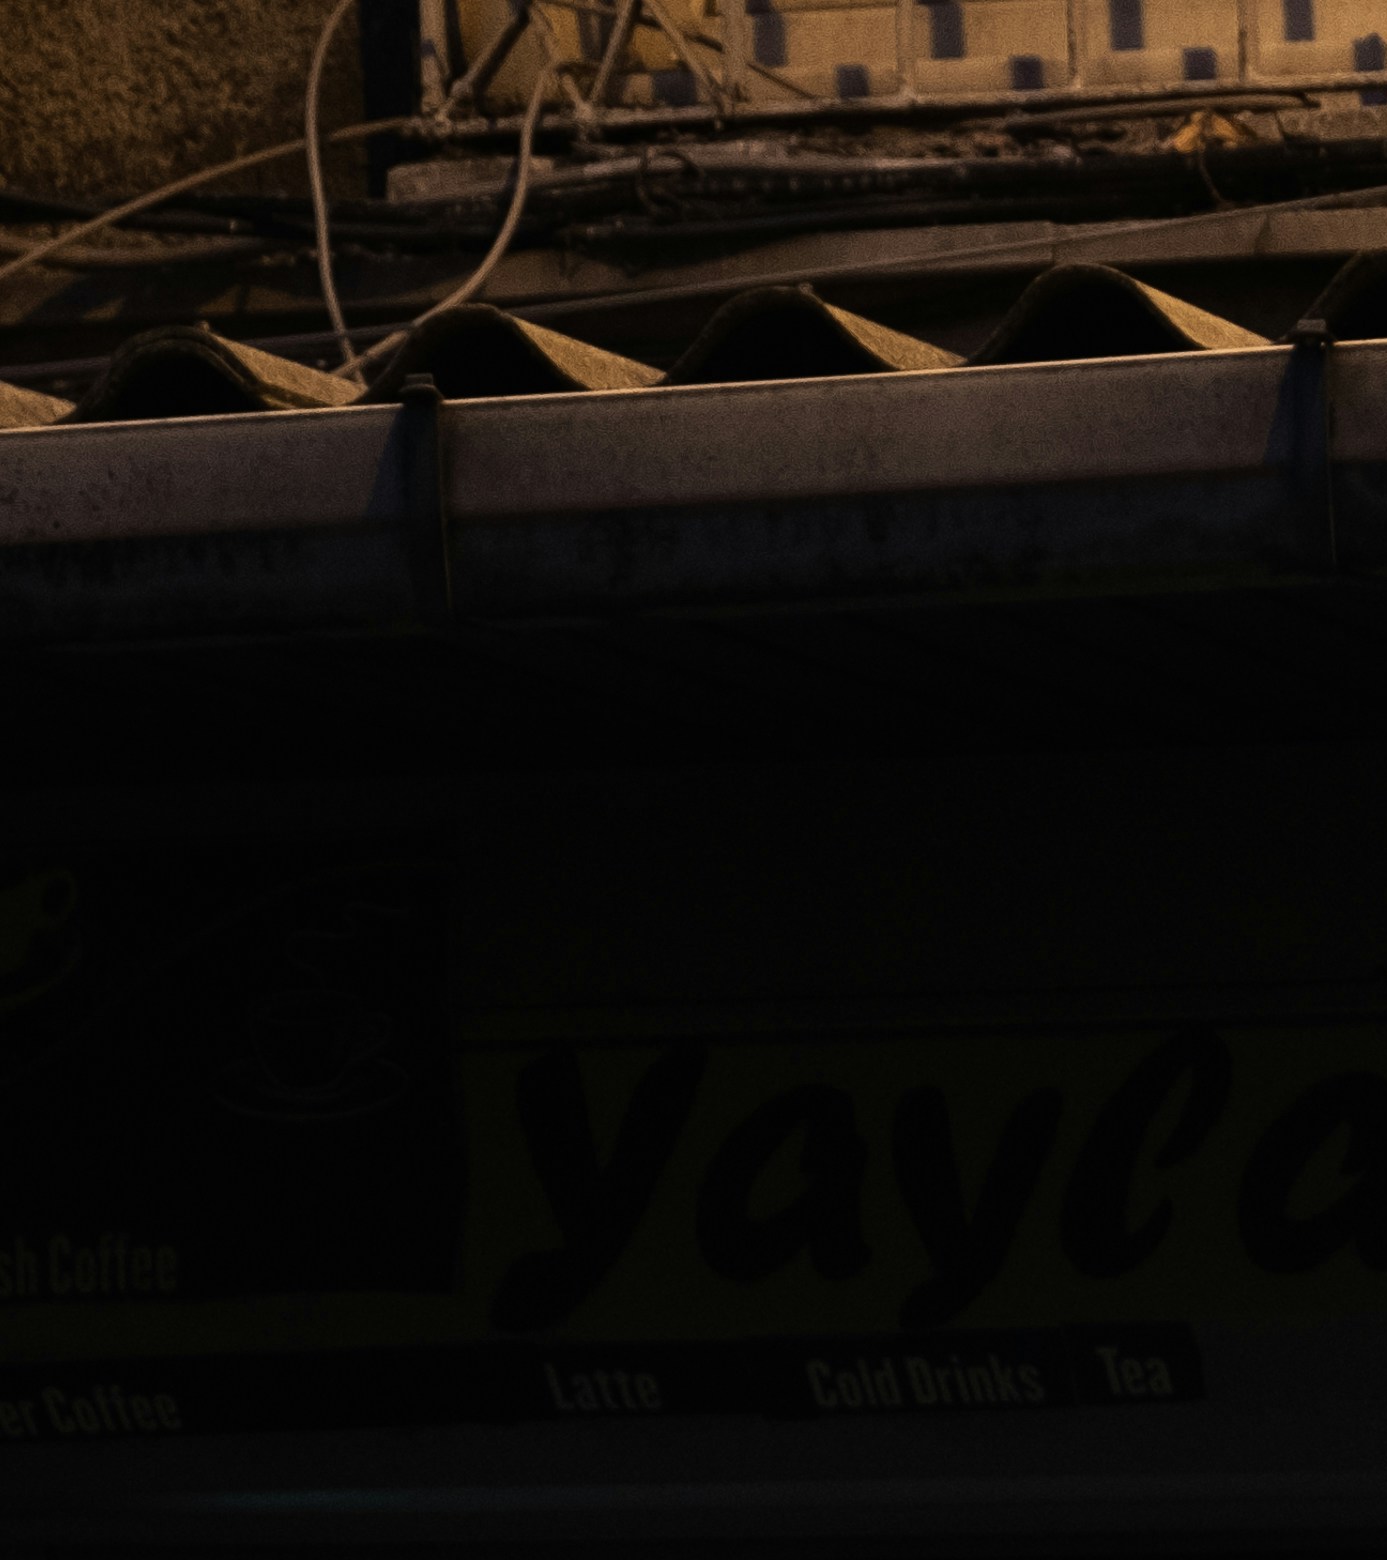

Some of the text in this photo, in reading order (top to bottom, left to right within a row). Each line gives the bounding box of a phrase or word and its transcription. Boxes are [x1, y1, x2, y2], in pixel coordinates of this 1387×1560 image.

[47, 1232, 179, 1296] Coffee
[41, 1383, 182, 1435] Coffee
[545, 1345, 1173, 1416] Latte Cold Drinks Tea
